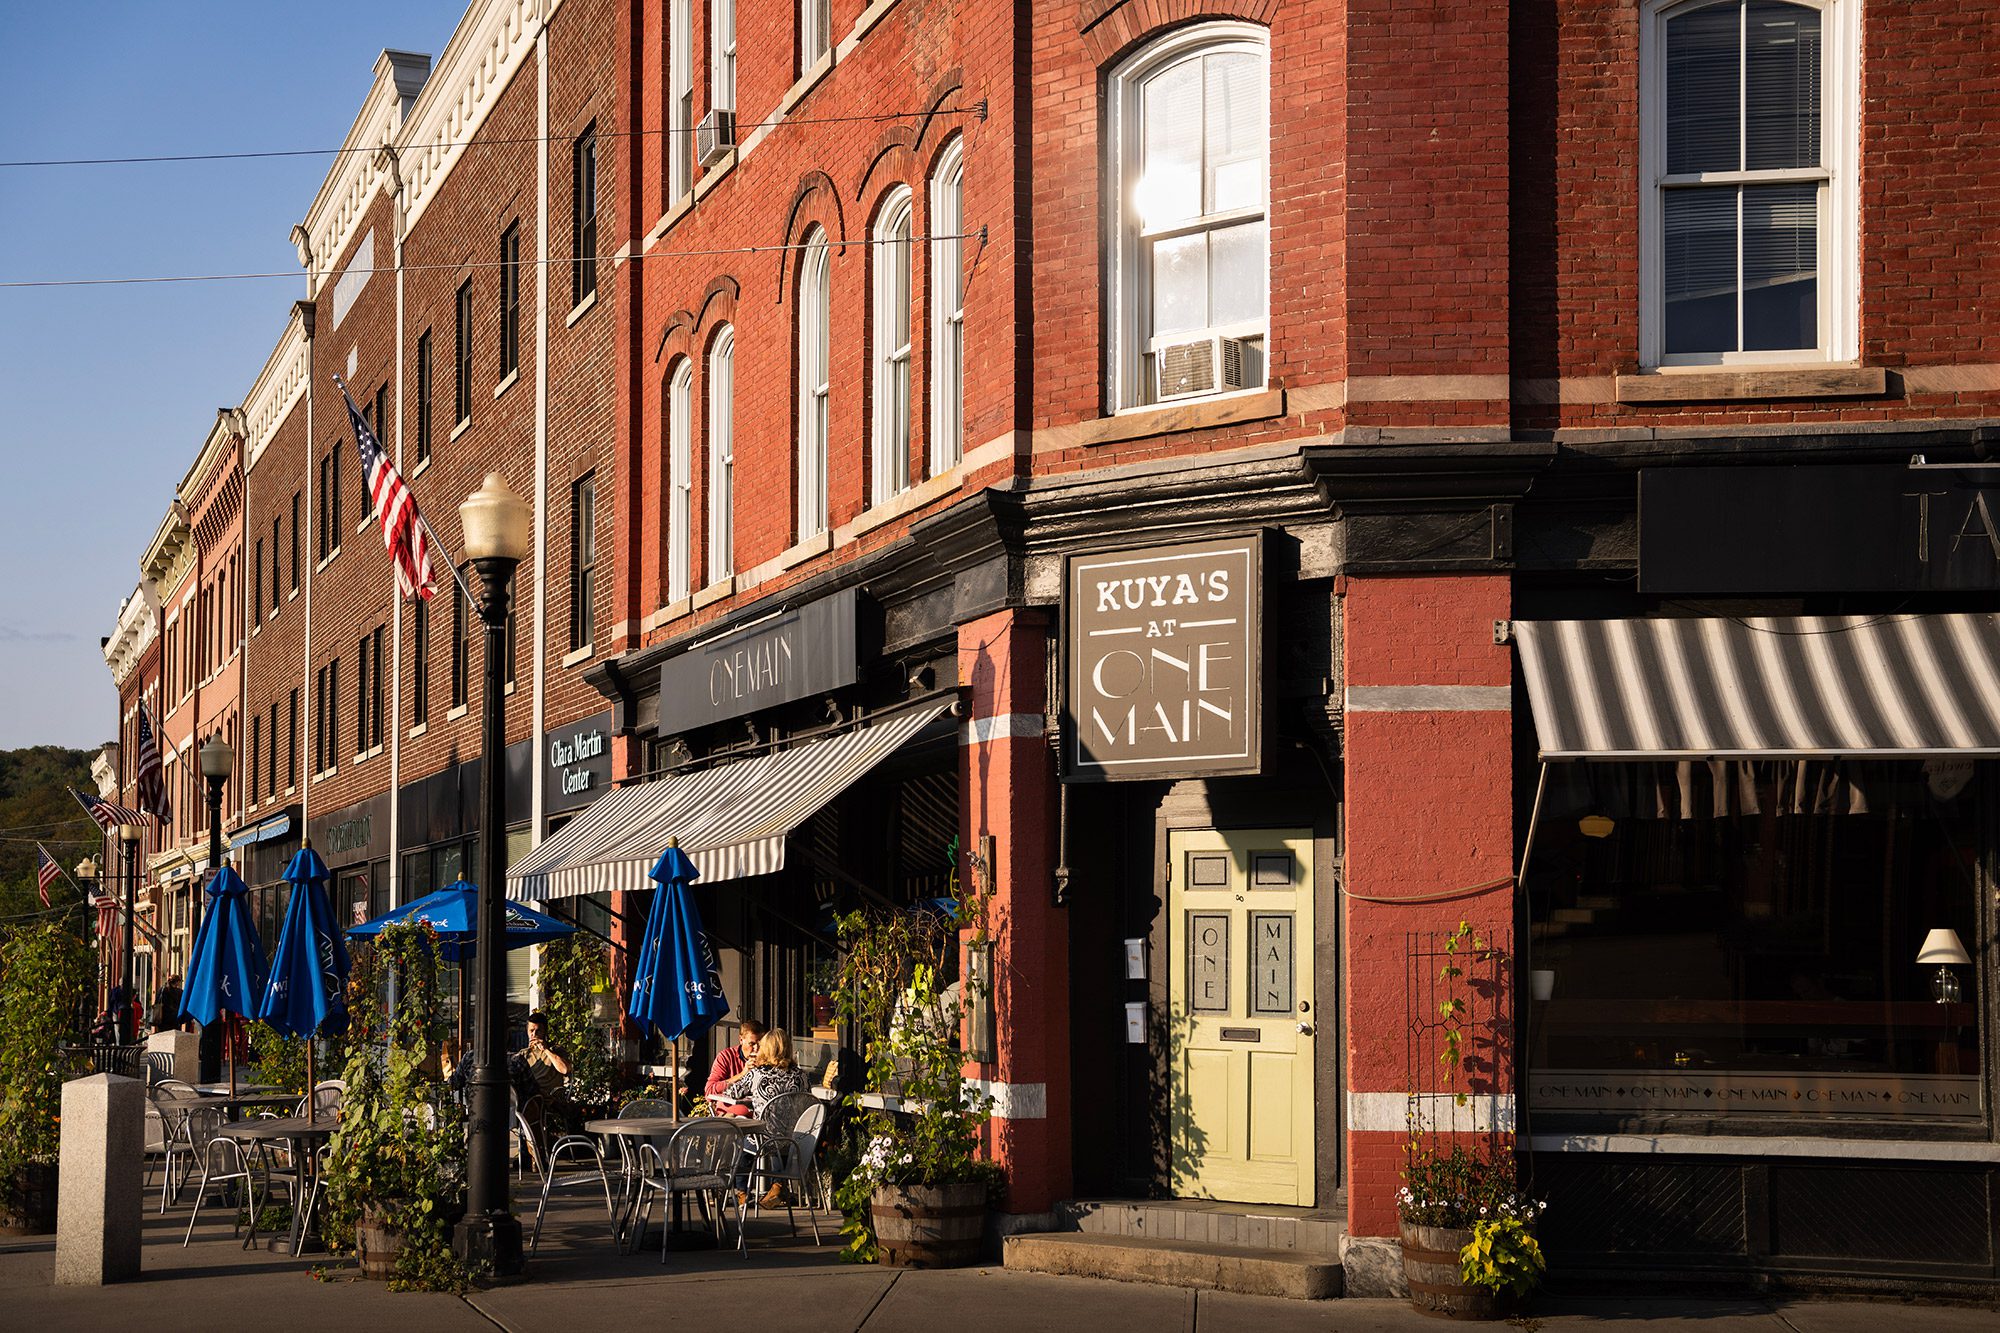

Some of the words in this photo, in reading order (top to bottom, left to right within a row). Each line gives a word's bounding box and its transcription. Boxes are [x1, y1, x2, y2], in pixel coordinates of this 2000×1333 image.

[1096, 570, 1229, 612] KUYA'S
[1146, 618, 1177, 638] AT
[1092, 641, 1232, 699] ONE
[1092, 696, 1232, 748] MAIN
[551, 739, 573, 768] Clara
[574, 729, 602, 761] Martin
[562, 767, 590, 795] Center
[1202, 927, 1218, 999] ONE
[1266, 923, 1281, 1007] MAIN
[1539, 1086, 1570, 1098] ONE
[1575, 1086, 1612, 1098] MAIN
[1630, 1086, 1659, 1098] ONE
[1663, 1087, 1699, 1098] MAIN
[1717, 1088, 1745, 1100] ONE
[1751, 1088, 1787, 1100] MAIN
[1897, 1092, 1928, 1104] ONE
[1933, 1092, 1970, 1104] MAIN
